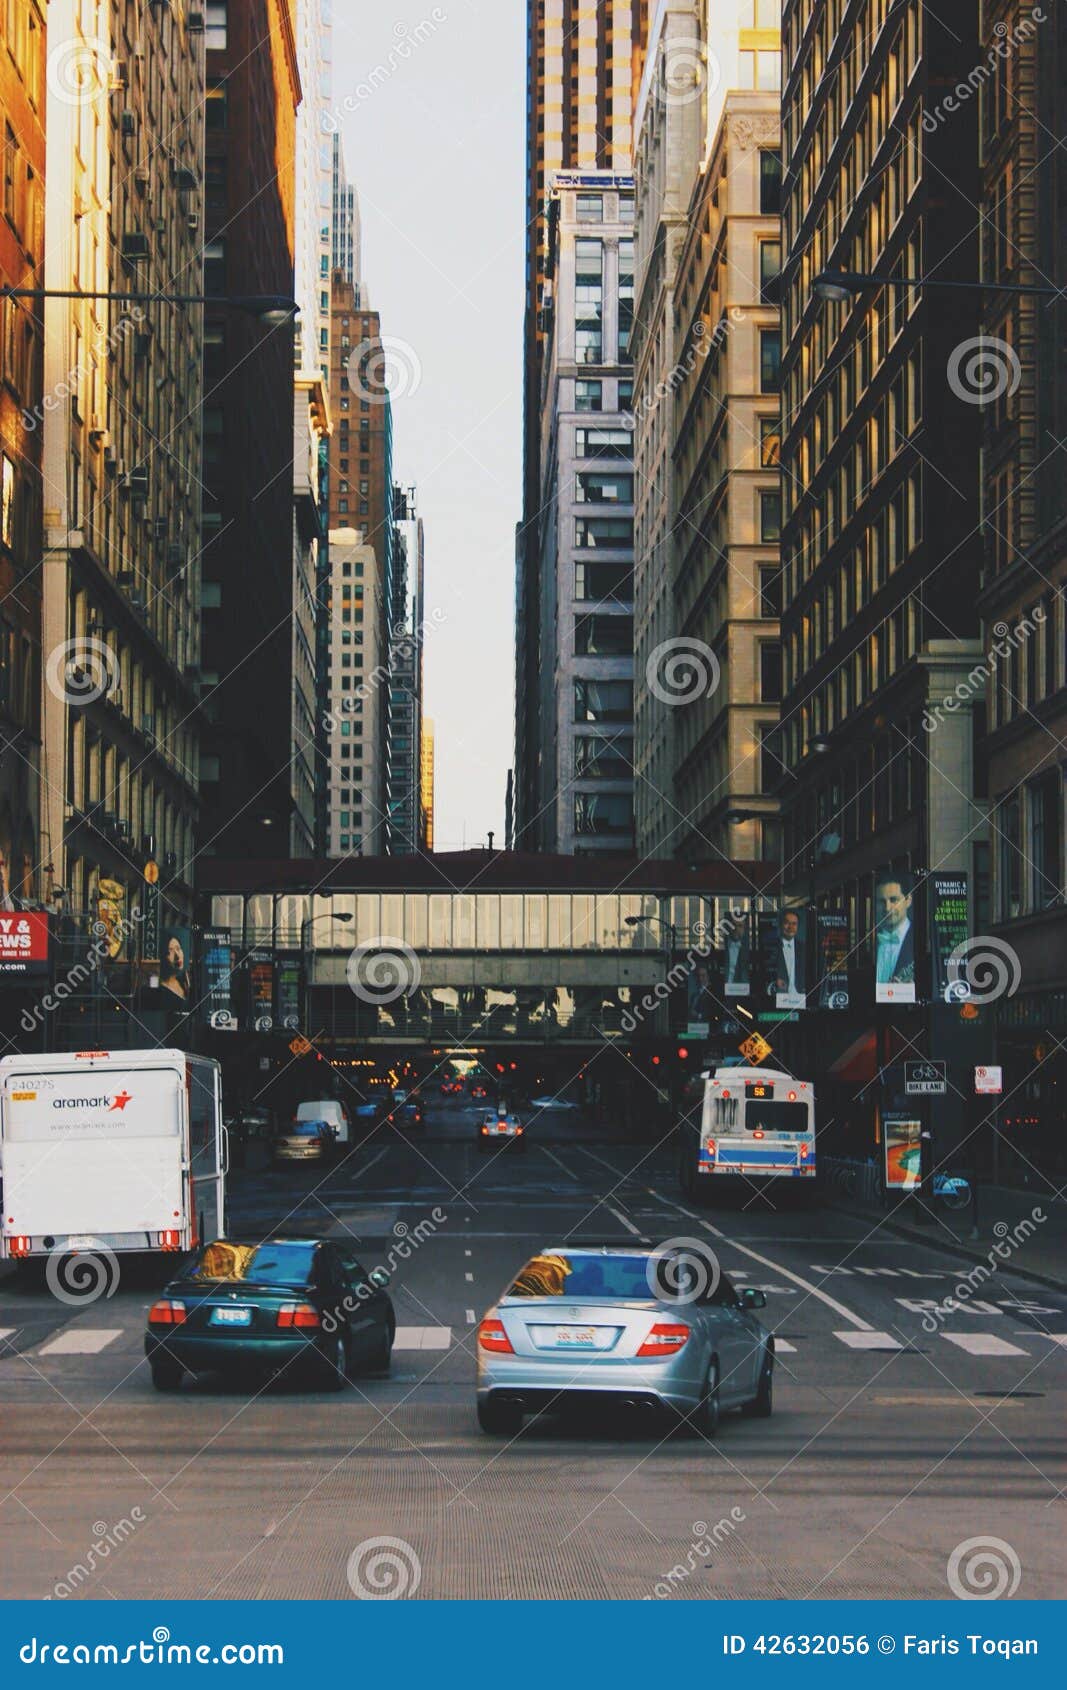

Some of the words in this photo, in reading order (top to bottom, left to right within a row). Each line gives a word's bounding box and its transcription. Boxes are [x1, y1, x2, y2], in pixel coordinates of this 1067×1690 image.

[17, 920, 30, 934] &
[909, 1083, 922, 1091] BIKE
[926, 1083, 943, 1091] LANE
[53, 1096, 110, 1109] aramark
[895, 1299, 1063, 1315] BUS
